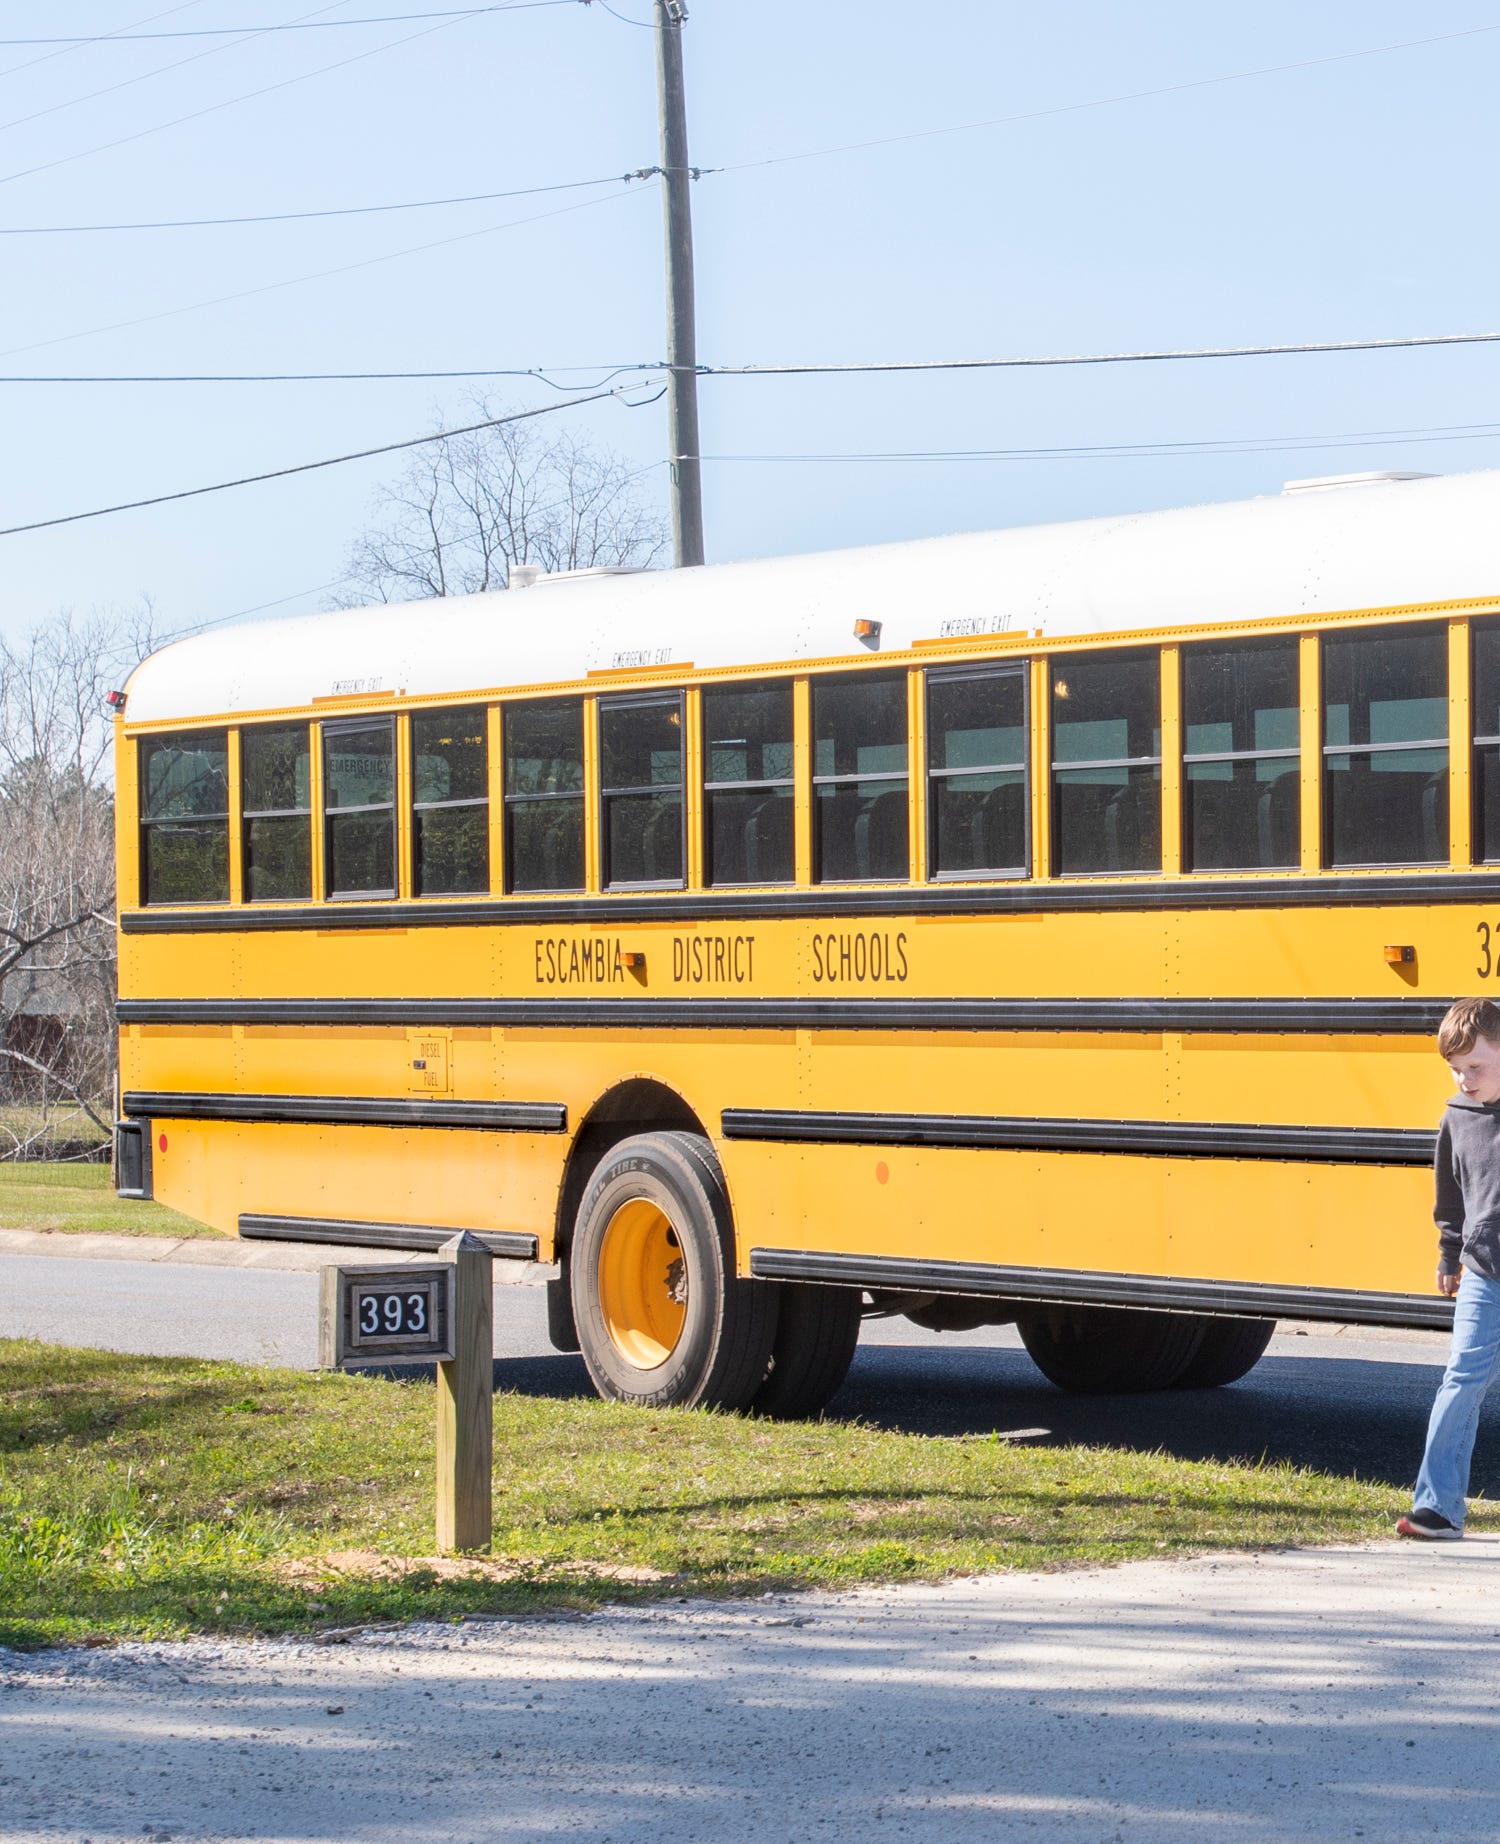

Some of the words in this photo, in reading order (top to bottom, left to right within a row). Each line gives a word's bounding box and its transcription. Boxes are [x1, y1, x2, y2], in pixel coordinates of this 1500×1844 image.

[940, 617, 987, 637] EMERGENCY
[991, 614, 1012, 632] EXIT
[612, 650, 651, 668] EMERGENCY
[655, 647, 672, 664] EXIT
[330, 759, 390, 774] EMERGENCY
[535, 938, 624, 983] ESCAMBIA
[673, 936, 755, 983] DISTRICT
[812, 932, 908, 982] SCHOOLS
[420, 1042, 440, 1058] DIESEL
[424, 1071, 439, 1086] FUEL
[360, 1294, 426, 1333] 393
